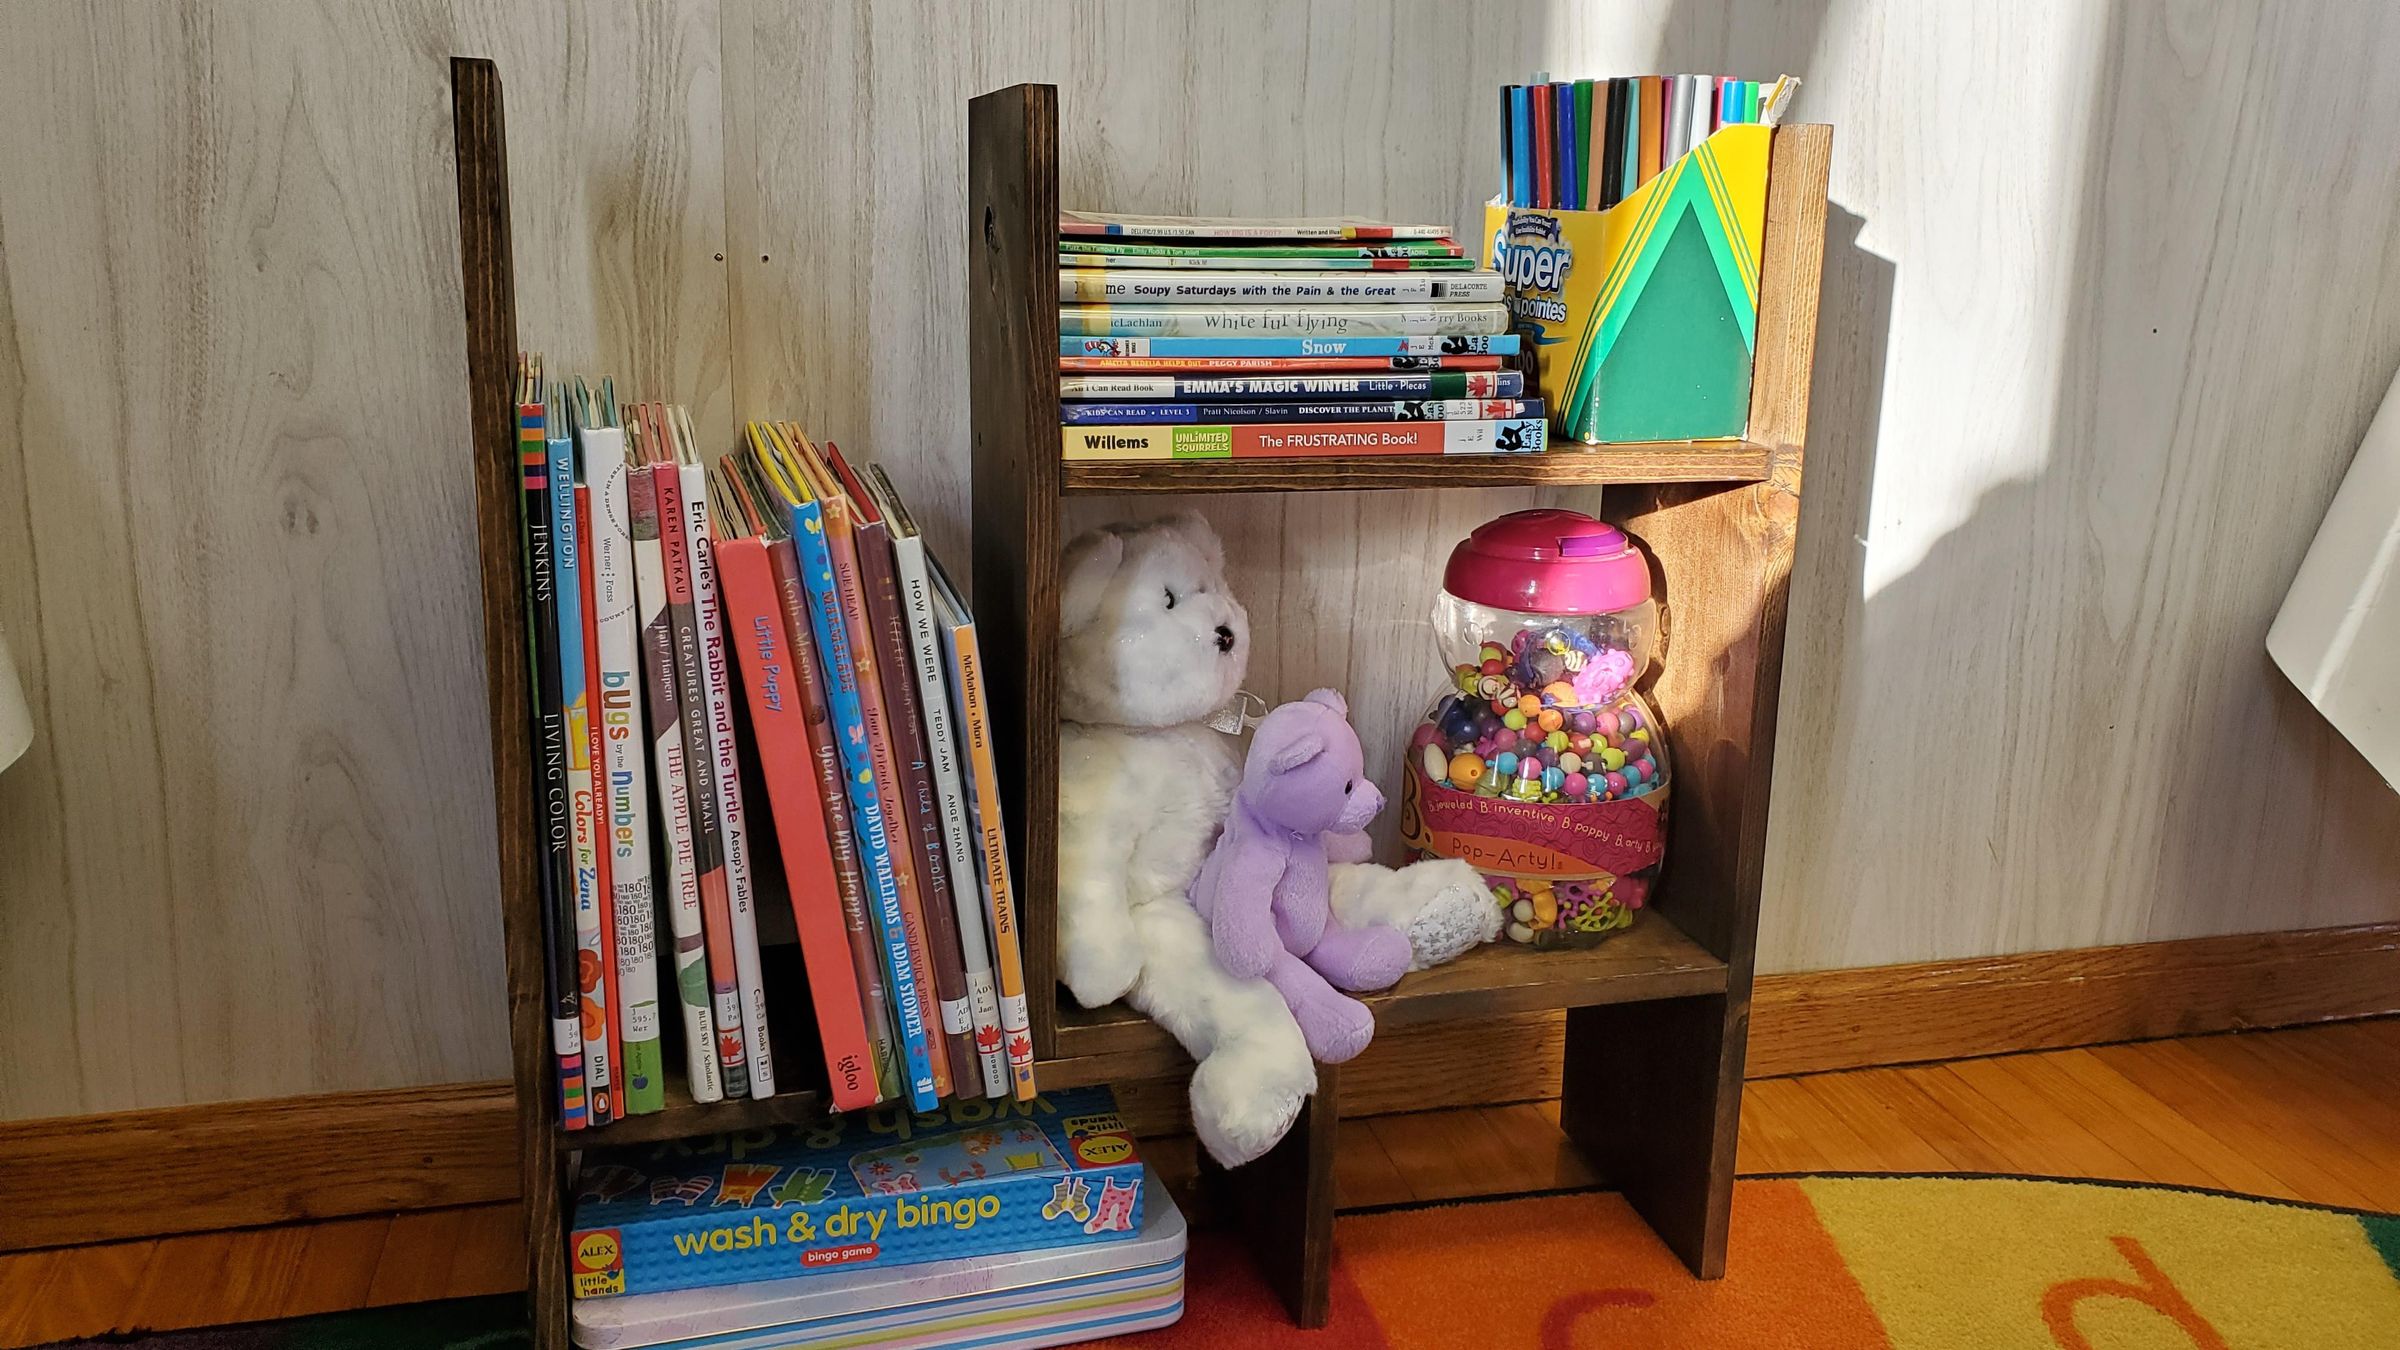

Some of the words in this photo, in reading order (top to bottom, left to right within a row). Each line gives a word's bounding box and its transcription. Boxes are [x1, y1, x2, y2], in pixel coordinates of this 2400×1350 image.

[1494, 232, 1571, 291] Super
[1134, 285, 1171, 299] Soupy
[1176, 285, 1237, 298] Saturdays
[1242, 284, 1267, 296] with
[1272, 285, 1291, 296] the
[1296, 285, 1321, 296] Pain
[1326, 286, 1335, 296] &
[1340, 285, 1360, 296] the
[1365, 286, 1396, 296] Great
[1450, 283, 1488, 291] DELACORTE
[1110, 316, 1163, 329] cLachlan
[1262, 309, 1290, 330] fur
[1297, 309, 1348, 334] flying
[1457, 314, 1488, 323] Books
[1521, 295, 1567, 322] pointes
[1100, 359, 1129, 367] AMELIA
[1131, 359, 1161, 367] BEDELIA
[1163, 359, 1186, 367] HELPS
[1187, 359, 1201, 367] OUT
[1209, 359, 1237, 367] PEGGY
[1240, 359, 1272, 367] PARISH
[1302, 339, 1348, 355] Snow
[1092, 384, 1109, 392] Can
[1111, 384, 1131, 392] Read
[1133, 384, 1154, 392] Book
[1184, 381, 1244, 393] EMMA'S
[1249, 380, 1299, 393] MAGIC
[1303, 380, 1359, 393] WINTER
[1369, 380, 1393, 391] Little
[1400, 379, 1427, 391] Plecas
[1203, 407, 1221, 415] Pratt
[1223, 407, 1256, 415] Nicolson
[1265, 406, 1288, 415] Slavin
[1299, 406, 1340, 414] DISCOVER
[1342, 406, 1360, 414] THE
[1084, 435, 1149, 449] Willems
[1175, 443, 1229, 453] SQUIRRELS
[1259, 435, 1283, 448] The
[1287, 433, 1378, 448] FRUSTRATING
[1382, 432, 1418, 445] Book!
[1521, 420, 1535, 450] Easy
[1534, 419, 1543, 453] Books
[556, 457, 575, 570] WELLINGTON
[664, 487, 684, 534] KAREN
[691, 500, 706, 533] Eric
[531, 524, 552, 601] JENKINS
[602, 536, 614, 571] Werner
[670, 541, 686, 594] PATKAU
[696, 536, 714, 591] Carle's
[604, 579, 616, 603] Forss
[839, 562, 851, 585] SUE
[845, 586, 859, 620] HEAP
[911, 580, 926, 611] HOW
[701, 593, 718, 631] The
[917, 617, 931, 639] WE
[655, 624, 671, 647] Hall
[753, 616, 774, 660] Little
[782, 577, 802, 617] Koth
[794, 631, 815, 685] Mason
[822, 589, 855, 694] MARMALADE
[661, 659, 675, 701] Halpern
[680, 626, 700, 703] CREATURES
[706, 636, 728, 695] Rabbit
[922, 644, 938, 683] WERE
[761, 665, 784, 712] Puppy
[963, 655, 979, 709] McMahon
[972, 719, 984, 748] Mora
[602, 670, 632, 741] bugs
[714, 701, 731, 733] and
[592, 730, 600, 756] LOVE
[690, 708, 706, 752] GREAT
[933, 709, 947, 744] TEDDY
[544, 713, 563, 781] LIVING
[615, 744, 625, 755] by
[617, 755, 627, 768] the
[666, 743, 682, 778] THE
[718, 738, 735, 768] the
[939, 747, 951, 774] JAM
[593, 759, 602, 777] YOU
[696, 759, 710, 786] AND
[816, 744, 836, 785] You
[911, 760, 927, 770] A
[594, 780, 604, 825] ALREADY!
[671, 783, 690, 833] APPLE
[722, 769, 741, 824] Turtle
[827, 791, 845, 822] Are
[947, 793, 960, 823] ANGE
[549, 788, 568, 853] COLOR
[574, 790, 593, 844] Colors
[611, 771, 637, 858] numbers
[701, 793, 715, 834] SMALL
[865, 804, 885, 849] DAVID
[880, 796, 900, 843] Together
[1480, 801, 1492, 814] B.
[1494, 802, 1555, 823] inventive
[1561, 816, 1573, 830] B.
[1615, 834, 1624, 847] B.
[1625, 838, 1643, 853] arty
[578, 848, 592, 866] for
[676, 839, 693, 863] PIE
[729, 829, 746, 874] Aesop's
[835, 830, 856, 862] My
[952, 826, 966, 864] ZHANG
[987, 828, 1003, 885] ULTIMATE
[1452, 837, 1555, 870] Pop-Arty!
[579, 867, 596, 912] Zena
[624, 882, 642, 893] 180
[679, 868, 697, 910] TREE
[736, 876, 750, 913] Fables
[840, 871, 866, 932] Happy
[874, 853, 901, 924] WALLIAMS
[619, 905, 636, 915] 180
[994, 890, 1011, 933] TRAINS
[620, 947, 636, 956] 180
[890, 942, 910, 980] ADAM
[904, 911, 925, 984] CANDLEWICK
[915, 987, 932, 1018] PRESS
[698, 1010, 708, 1032] BLUE
[900, 983, 922, 1038] STOWER
[701, 1032, 710, 1047] SKY
[757, 1025, 766, 1052] Books
[593, 1055, 606, 1081] DIAL
[704, 1054, 714, 1091] Scholastic
[837, 1054, 862, 1091] igloo
[1071, 1114, 1118, 1126] hands
[1087, 1121, 1124, 1132] little
[1083, 1143, 1128, 1156] ALEX
[673, 1215, 777, 1257] wash
[787, 1211, 816, 1244] &
[825, 1204, 887, 1241] dry
[896, 1194, 1001, 1231] bingo
[579, 1244, 615, 1259] ALEX
[807, 1249, 839, 1264] bingo
[841, 1245, 873, 1261] game
[580, 1276, 608, 1287] little
[583, 1283, 619, 1297] hands
